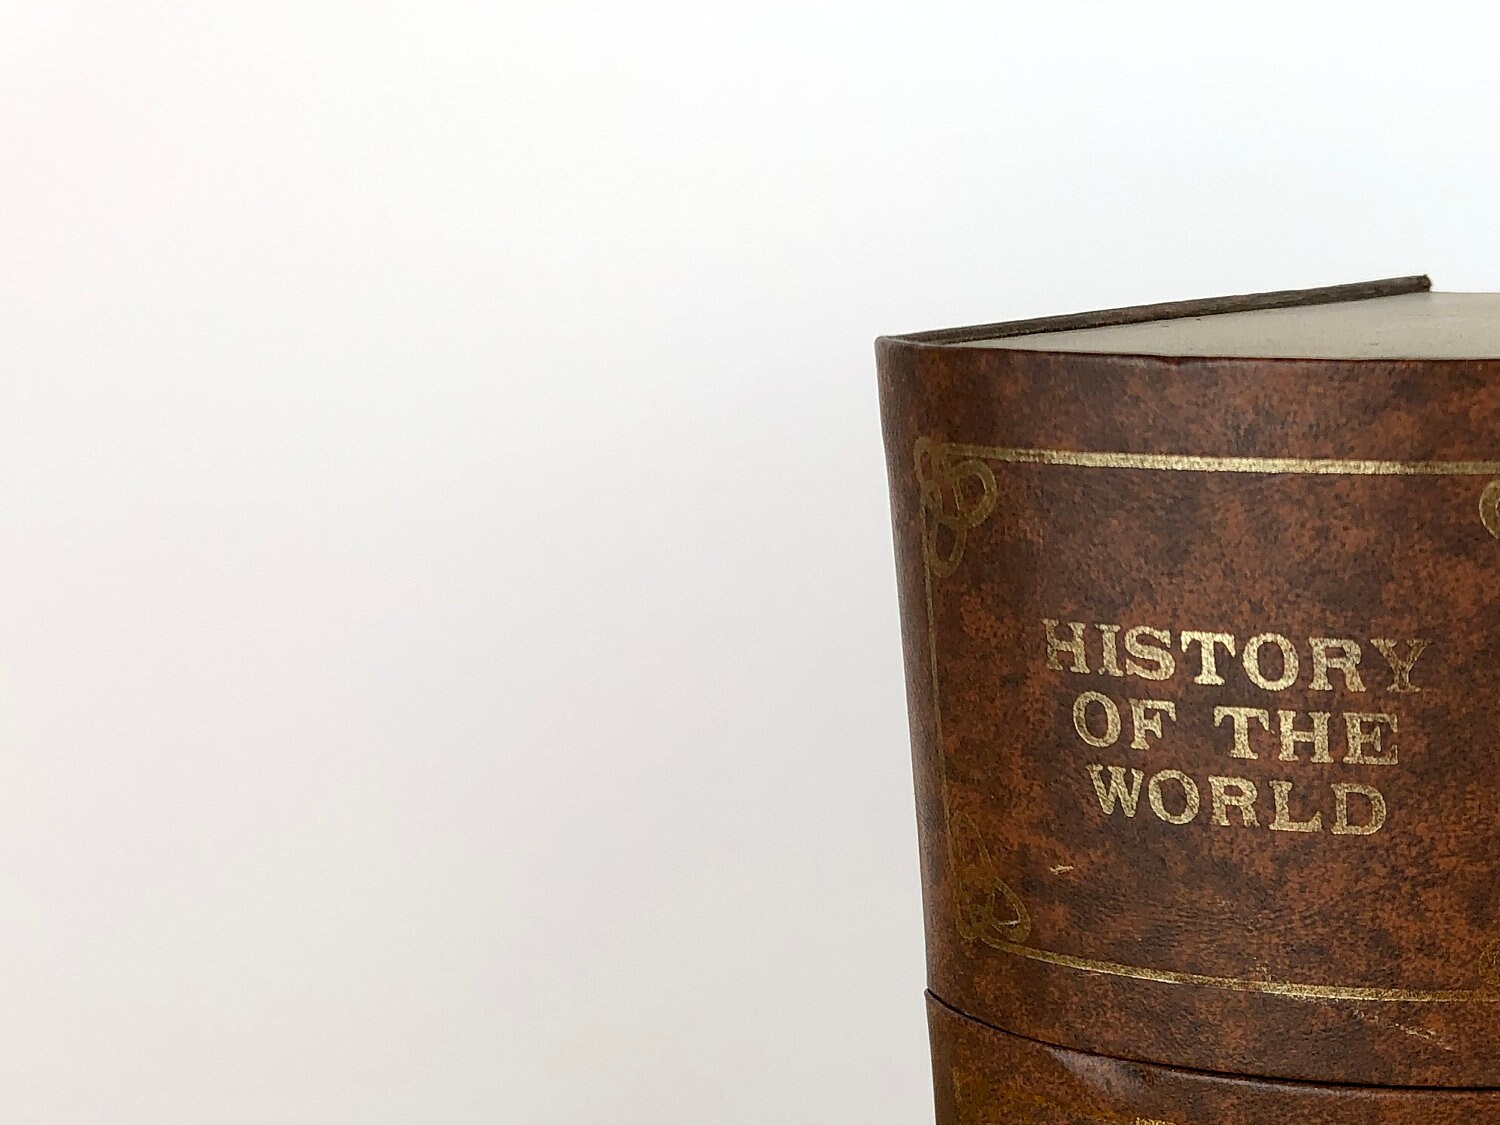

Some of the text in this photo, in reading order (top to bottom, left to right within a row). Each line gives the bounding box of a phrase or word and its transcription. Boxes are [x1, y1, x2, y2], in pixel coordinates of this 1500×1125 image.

[1041, 618, 1433, 693] HISTORY
[1072, 690, 1399, 766] OF THE
[1086, 763, 1387, 836] WORLD
